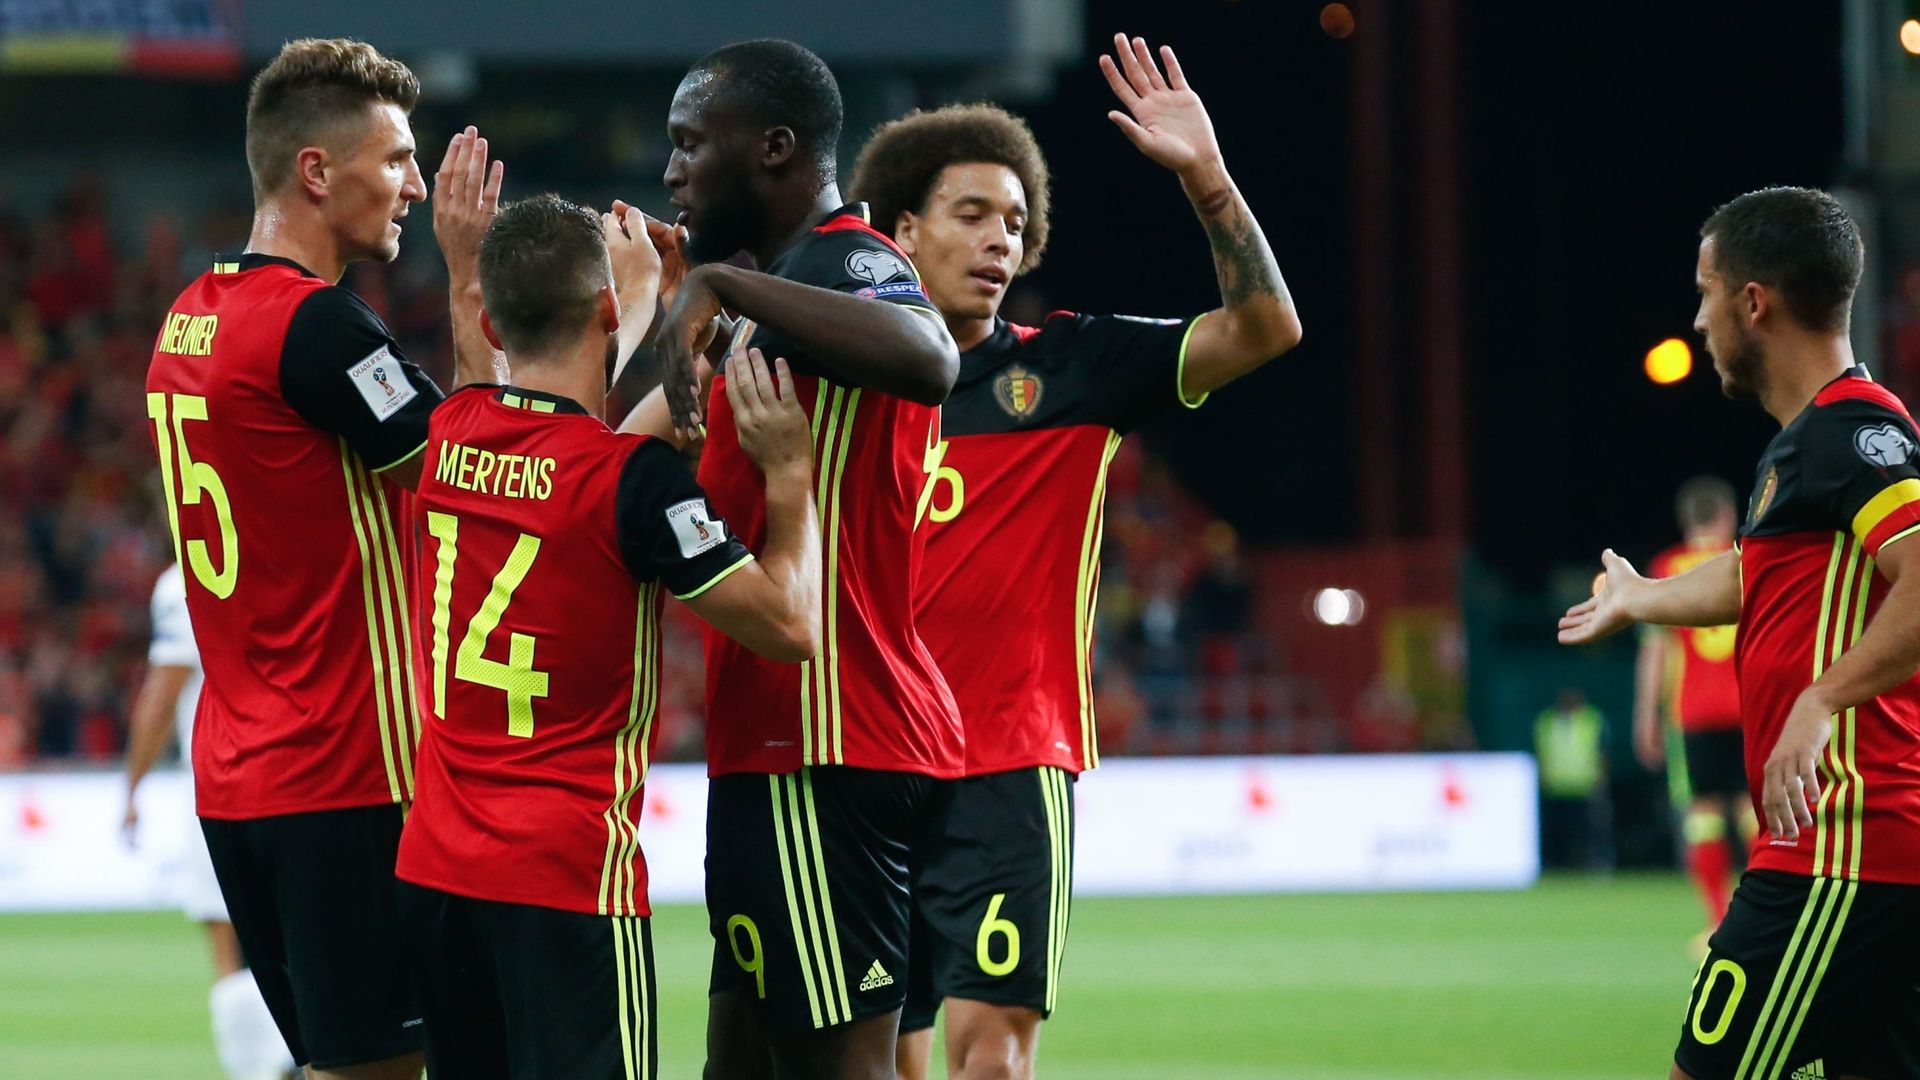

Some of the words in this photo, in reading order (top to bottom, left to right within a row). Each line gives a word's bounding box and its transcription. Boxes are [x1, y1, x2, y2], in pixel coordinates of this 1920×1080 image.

[158, 312, 219, 356] MEUNIER
[147, 392, 239, 600] 15
[435, 439, 556, 500] MERTENS
[427, 511, 549, 738] 14
[727, 914, 766, 999] 9
[976, 893, 1021, 977] 6
[859, 974, 895, 992] adidas
